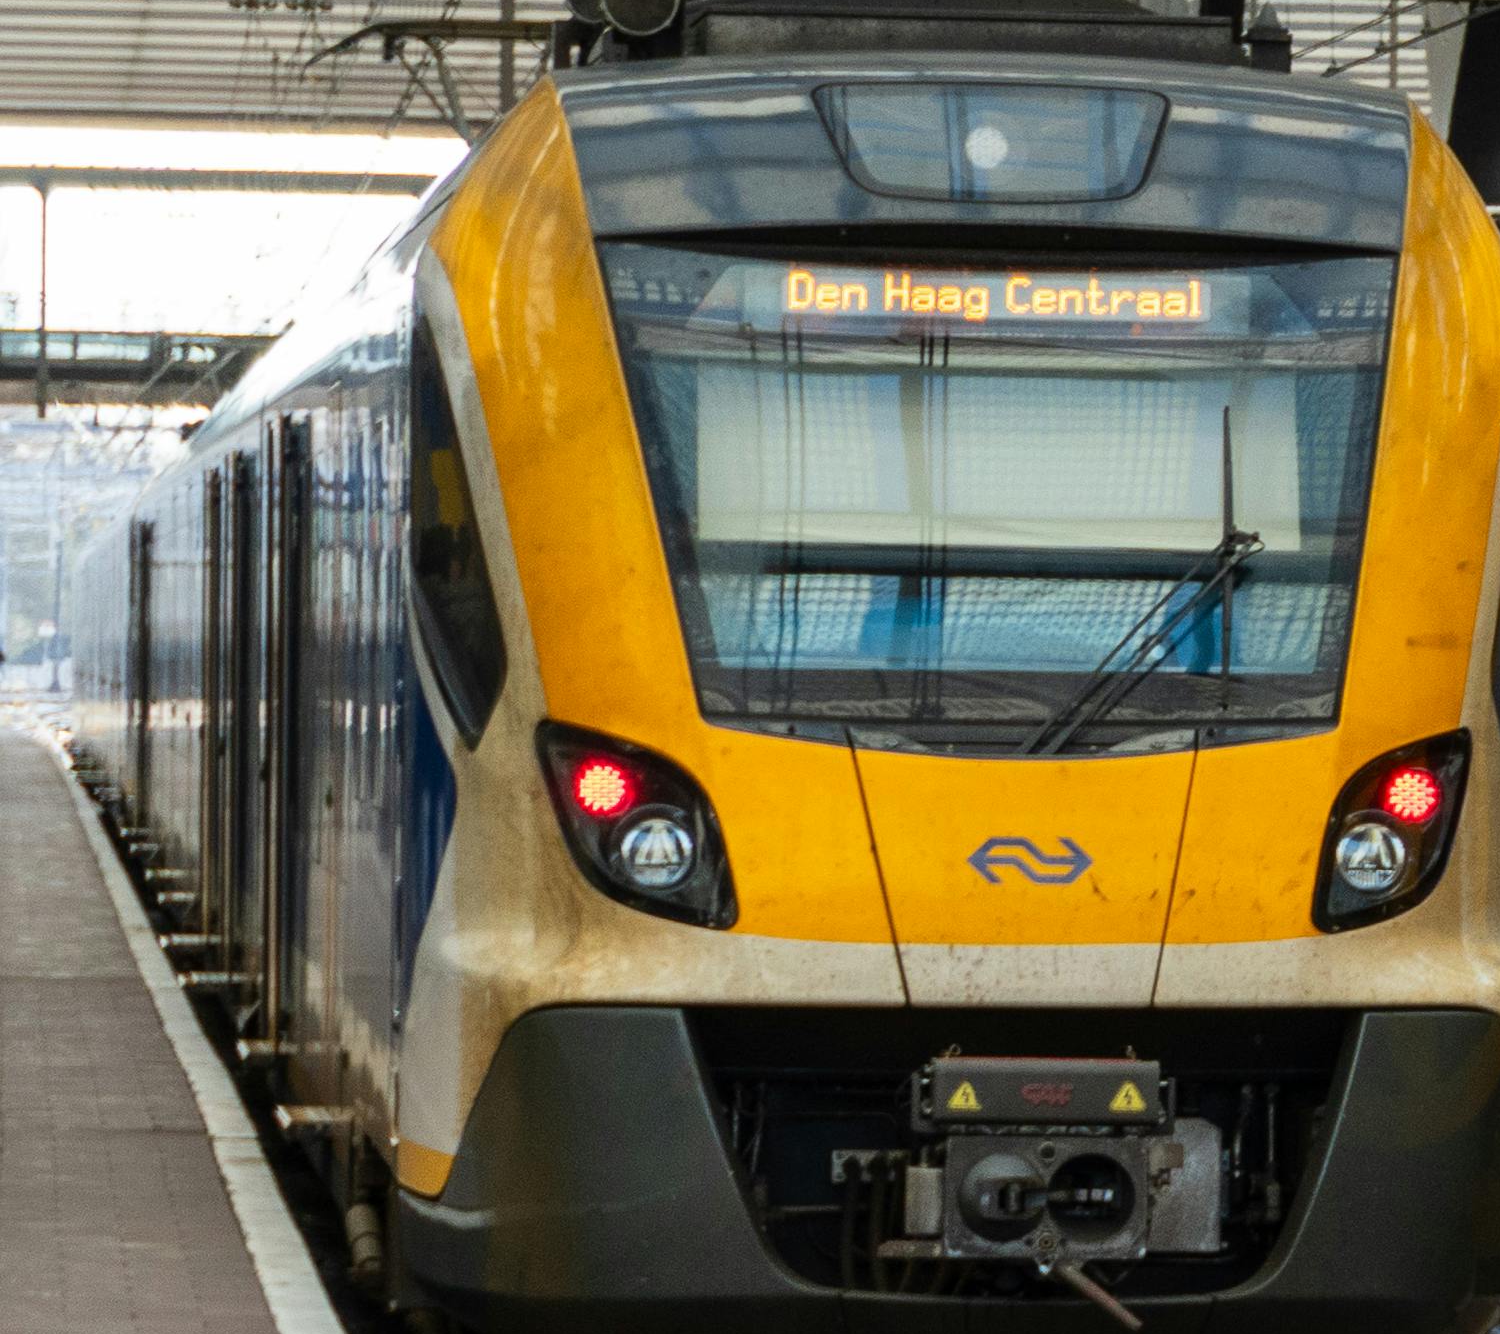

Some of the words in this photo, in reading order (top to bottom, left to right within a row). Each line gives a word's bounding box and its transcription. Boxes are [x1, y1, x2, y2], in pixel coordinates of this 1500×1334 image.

[787, 270, 868, 311] Den
[884, 273, 990, 321] Haag
[1005, 275, 1202, 317] Centraal
